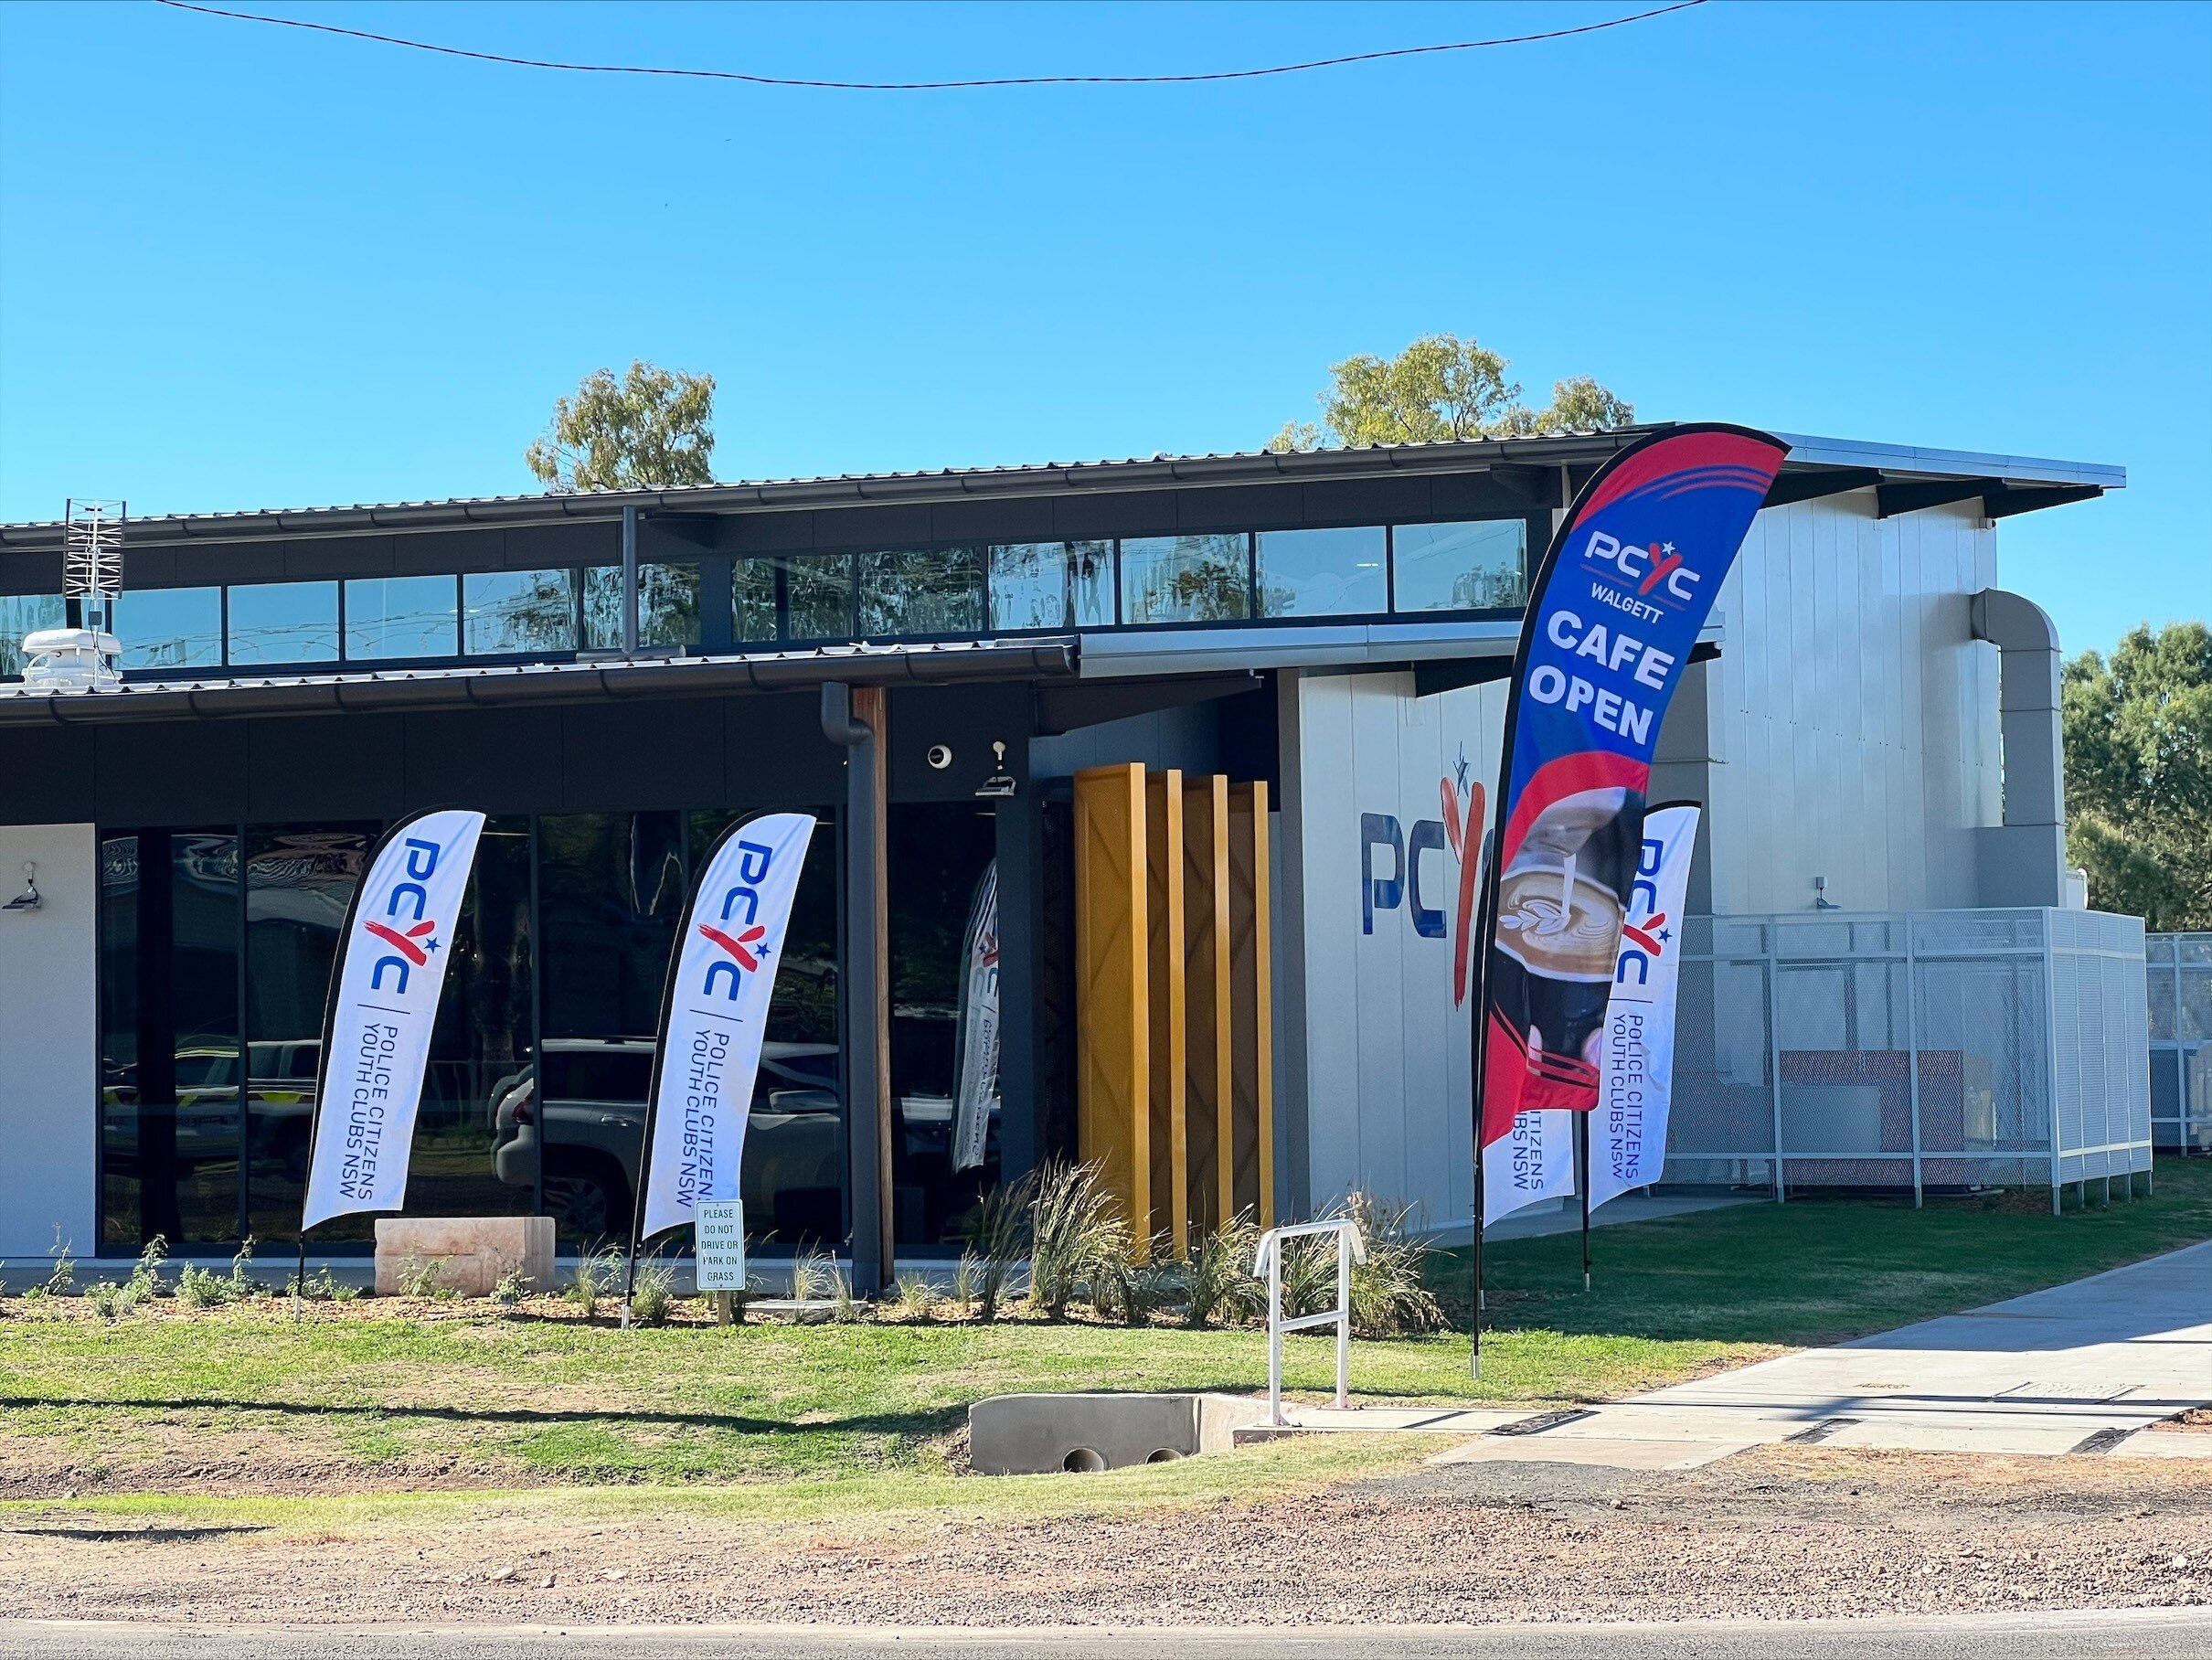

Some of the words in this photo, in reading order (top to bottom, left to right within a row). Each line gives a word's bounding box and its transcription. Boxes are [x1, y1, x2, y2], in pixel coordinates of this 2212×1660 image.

[1584, 530, 1701, 601] PCYC
[1590, 582, 1664, 624] WALGETT
[1547, 610, 1675, 690] CAFE
[1528, 665, 1654, 746] OPEN
[363, 837, 441, 995] PCYC
[697, 840, 773, 1002] PCYC
[1361, 777, 1494, 1011] PCY
[1617, 838, 1664, 985] PCYC
[356, 1023, 380, 1083] YOUTH
[372, 1026, 399, 1100] POLICE
[688, 1029, 711, 1091] YOUTH
[703, 1032, 729, 1108] POLICE
[1611, 1014, 1626, 1070] YOUTH
[1628, 1015, 1643, 1084] POLICE
[346, 1088, 369, 1149] CLUBS
[683, 1095, 700, 1157] CLUBS
[1610, 1076, 1624, 1133] CLUBS
[1626, 1091, 1643, 1179] CITIZENS
[340, 1154, 360, 1198] NSW
[358, 1106, 384, 1200] CITIZENS
[697, 1114, 715, 1200] CITIZEN
[1513, 1146, 1528, 1190] NSW
[1530, 1111, 1544, 1190] ITIZENS
[1611, 1138, 1623, 1179] NSW
[676, 1162, 697, 1208] NSW
[704, 1209, 733, 1218] PLEASE
[701, 1240, 724, 1250] DRIVE
[727, 1240, 739, 1250] OR
[703, 1256, 724, 1265] PARK
[726, 1256, 738, 1265] ON
[704, 1225, 716, 1234] DO
[718, 1225, 734, 1234] NOT
[707, 1272, 734, 1282] GRASS
